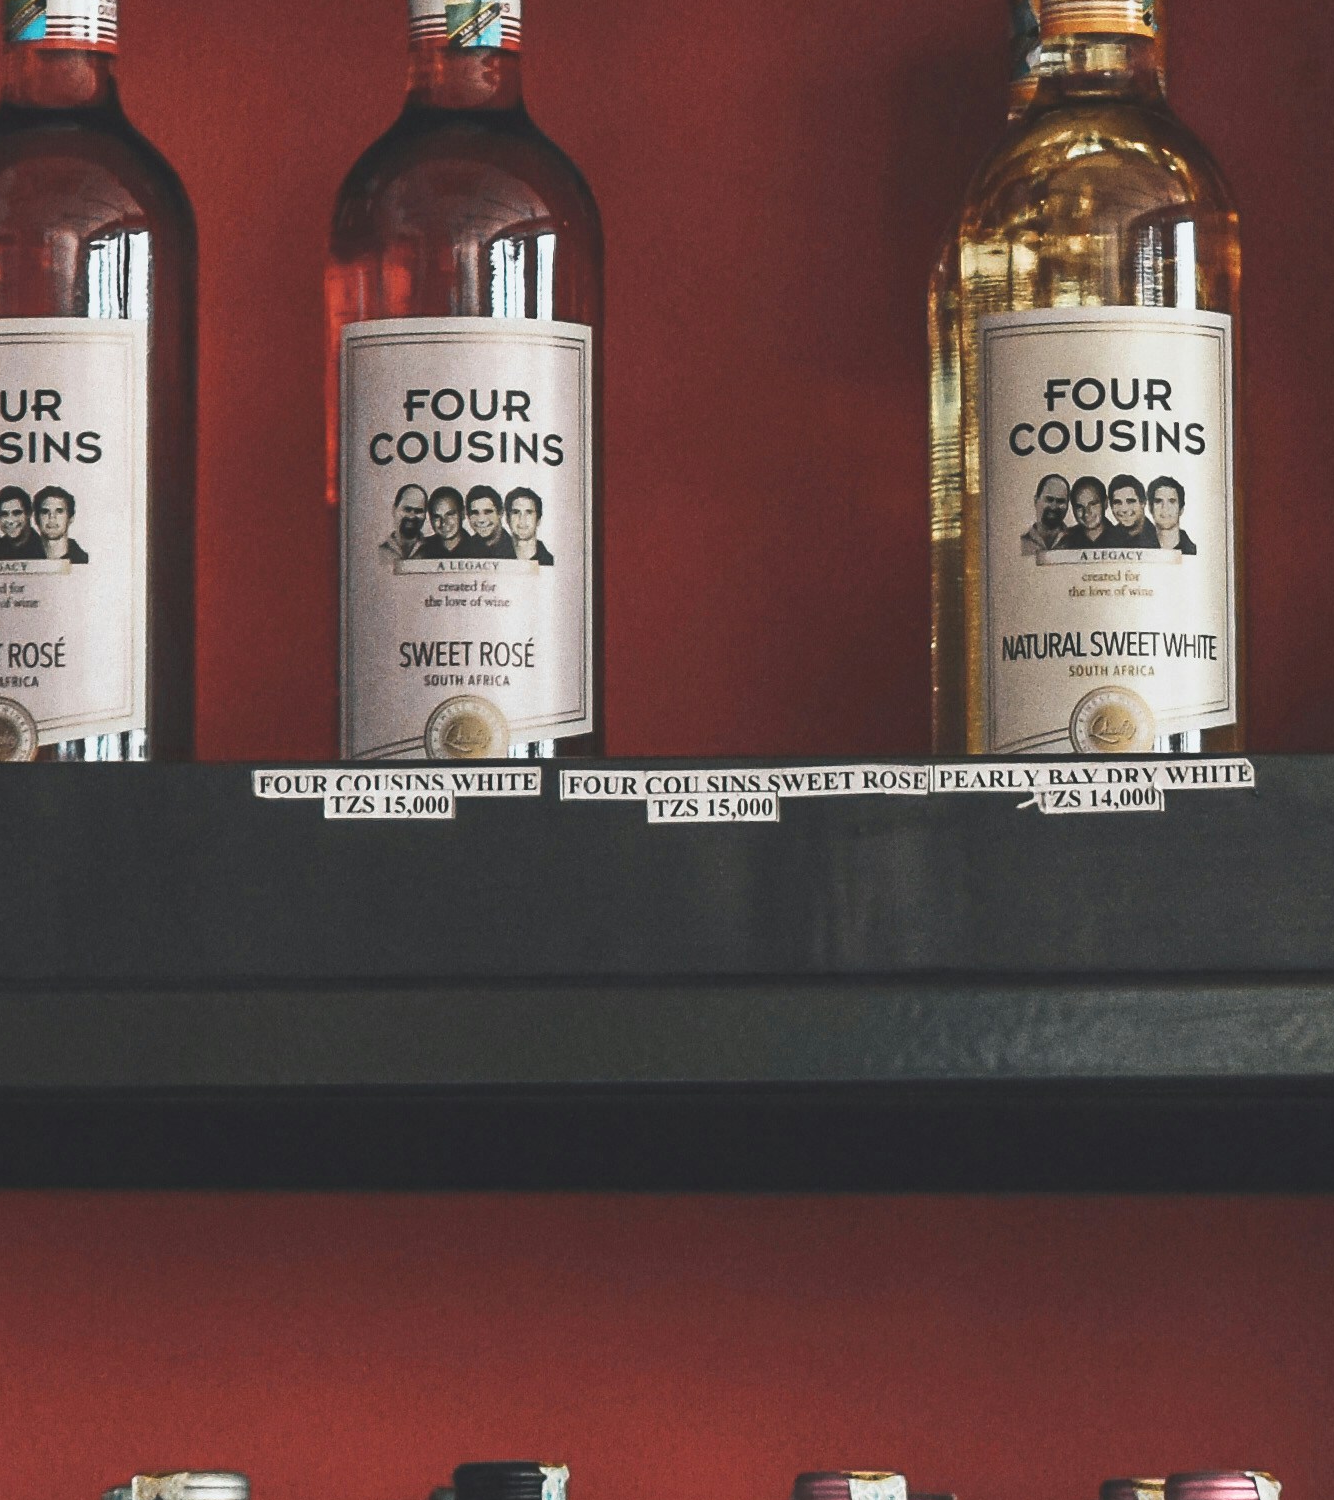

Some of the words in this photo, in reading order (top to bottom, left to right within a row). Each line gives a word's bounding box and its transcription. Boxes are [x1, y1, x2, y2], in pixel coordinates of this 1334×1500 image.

[403, 388, 531, 422] FOUR
[1043, 378, 1172, 412] FOUR
[369, 431, 564, 467] COUSINS
[1009, 419, 1206, 456] COUSINS
[450, 561, 499, 570] LEGACY
[1093, 551, 1143, 561] LEGACY
[8, 636, 66, 669] ROSÉ
[399, 641, 473, 668] SWEET
[479, 637, 535, 668] ROSÉ
[1002, 632, 1087, 661] NATURAL
[1090, 631, 1161, 657] SWEET
[1163, 633, 1217, 661] WHITE
[424, 674, 464, 687] SOUTH
[467, 674, 511, 686] AFRICA
[1068, 665, 1108, 677] SOUTH
[1113, 665, 1156, 677] AFRICA
[260, 775, 327, 795] FOUR
[335, 774, 444, 791] COUSINS
[452, 773, 537, 792] WHITE
[568, 775, 637, 795] FOUR
[767, 770, 854, 791] SWEET
[863, 770, 926, 791] ROSE
[939, 769, 1039, 789] PEARLY
[1050, 768, 1097, 784] BAY
[1109, 767, 1158, 784] DRY
[1167, 765, 1251, 785] WHITE
[331, 796, 375, 814] TZS
[383, 796, 450, 819] 15,000
[653, 799, 698, 817] TZS
[707, 797, 773, 820] 15,000
[1089, 789, 1157, 810] 14,000
